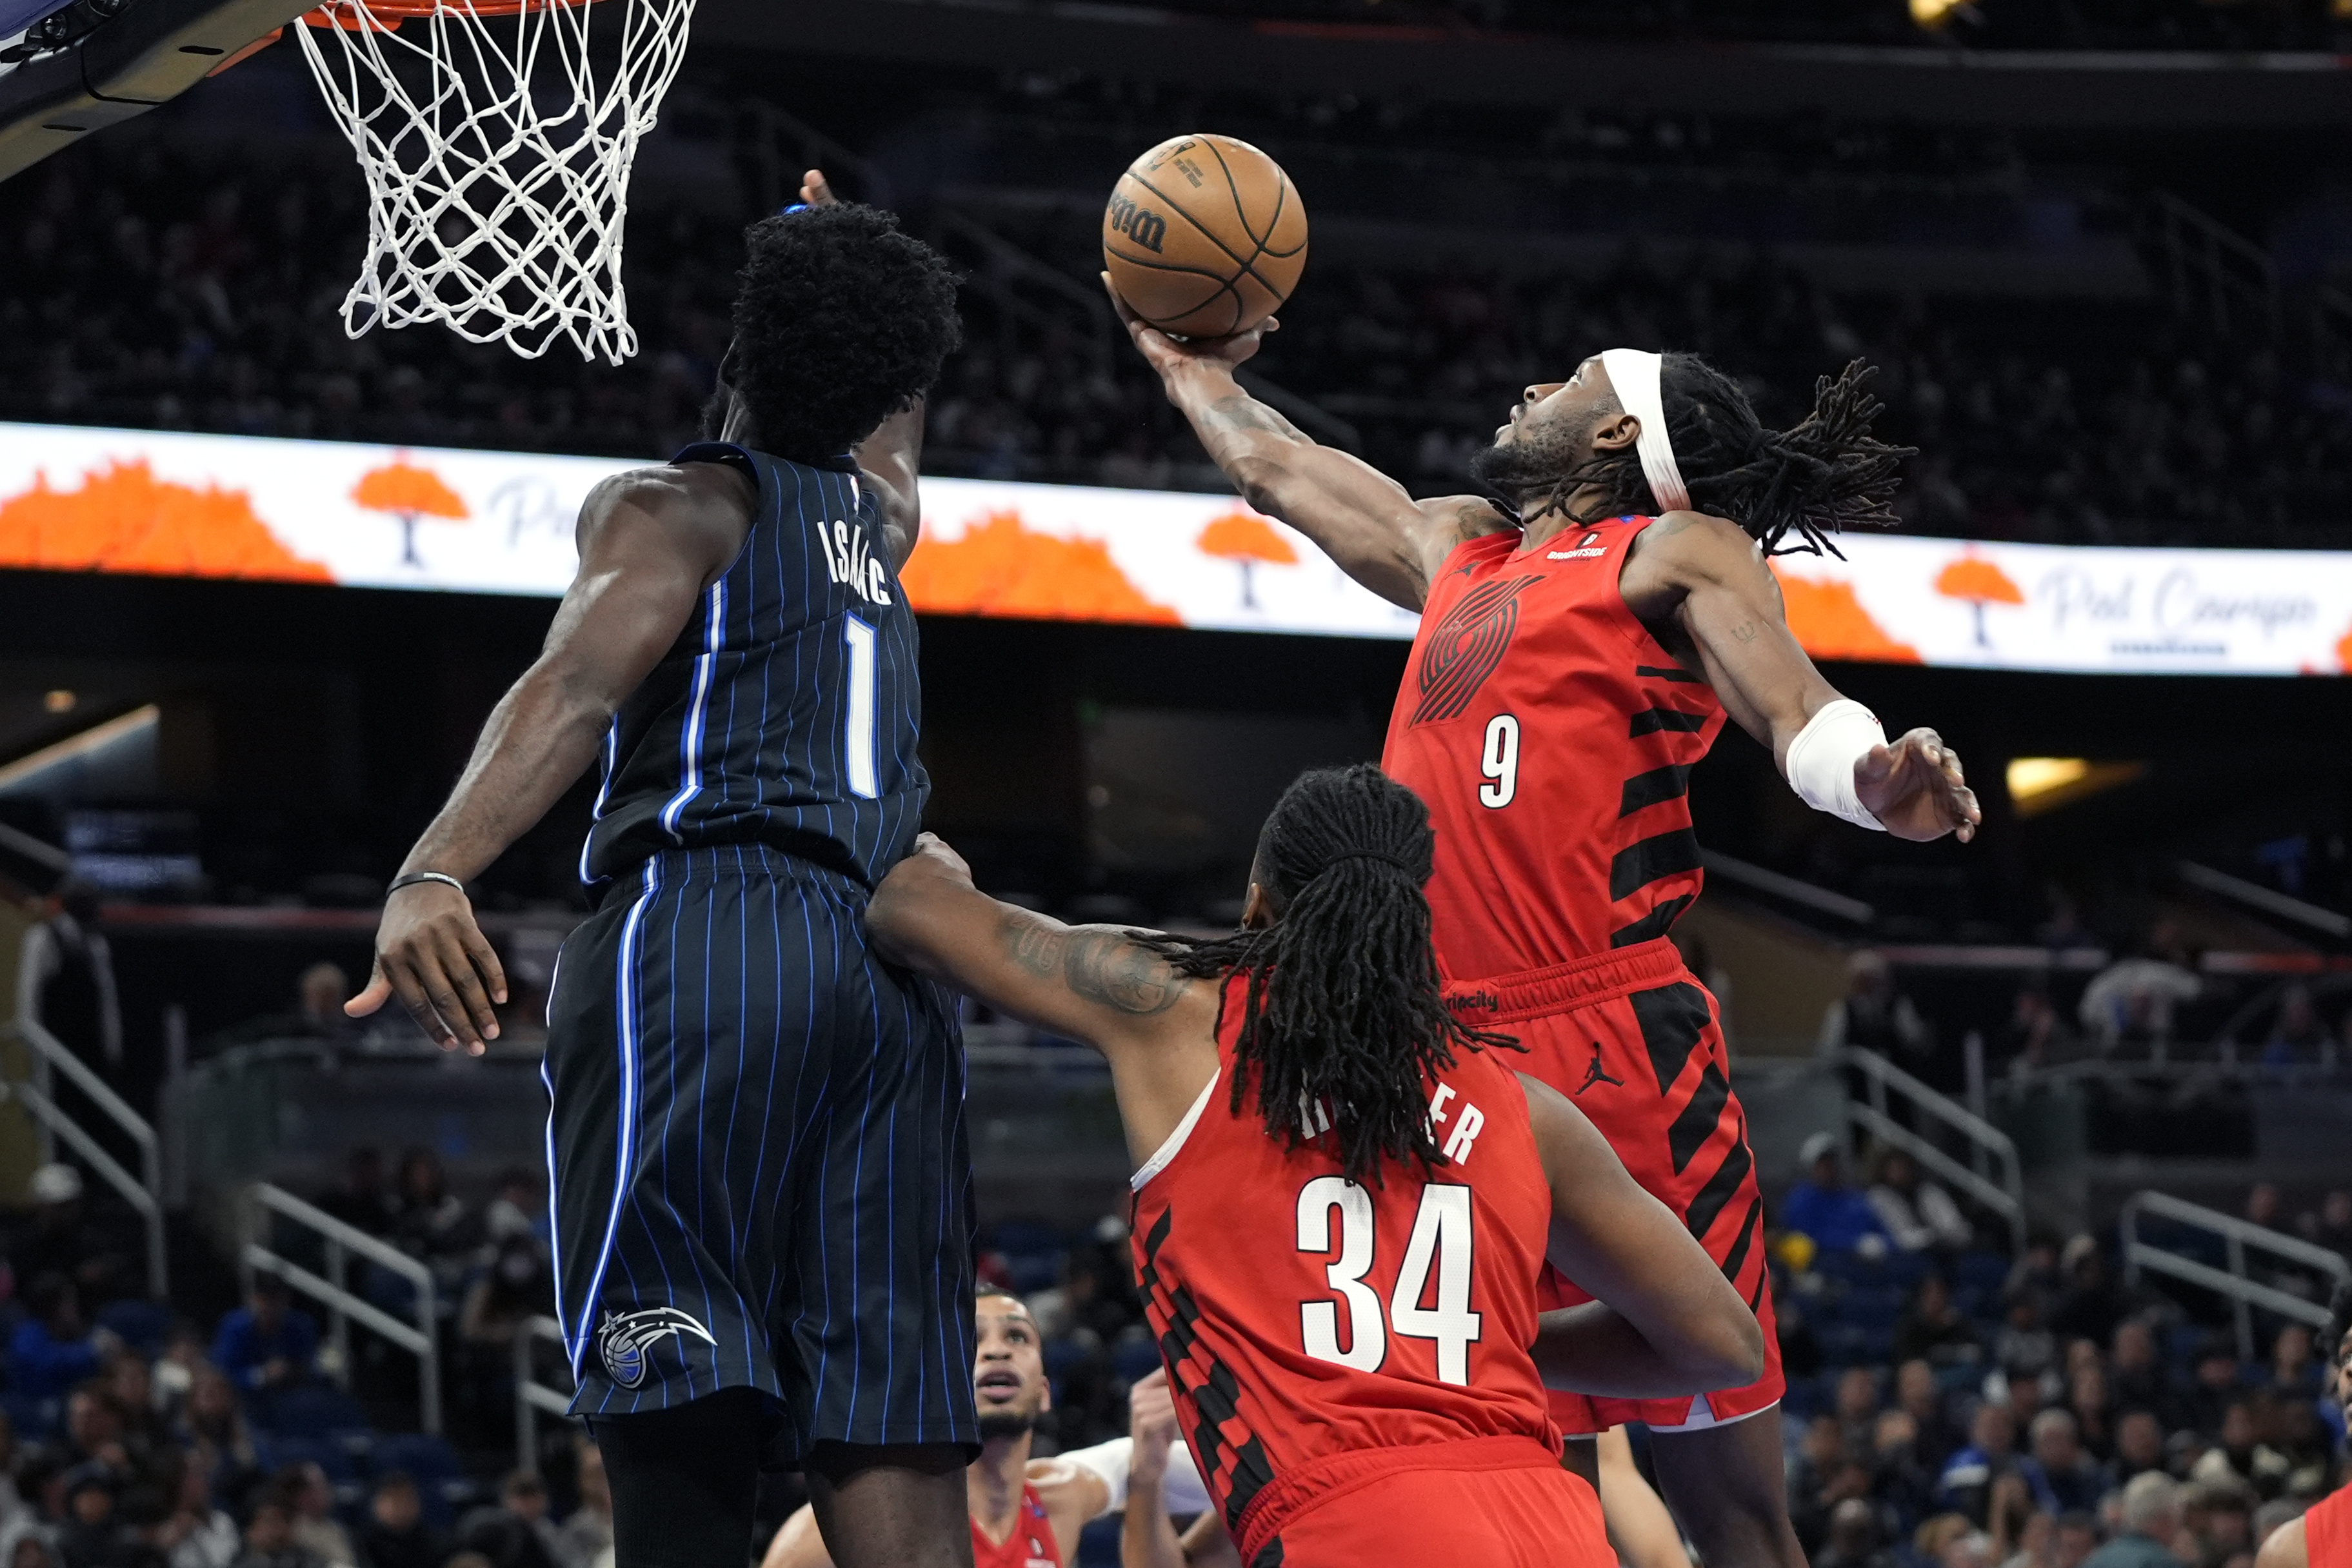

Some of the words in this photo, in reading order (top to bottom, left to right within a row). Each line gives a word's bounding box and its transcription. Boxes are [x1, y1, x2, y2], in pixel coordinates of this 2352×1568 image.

[817, 519, 892, 605] ISAAC
[1546, 546, 1608, 560] BRIGHTSIDE
[844, 609, 880, 799] 1
[1479, 713, 1520, 809] 9
[1446, 989, 1499, 1013] ripcity
[1296, 1175, 1482, 1387] 34
